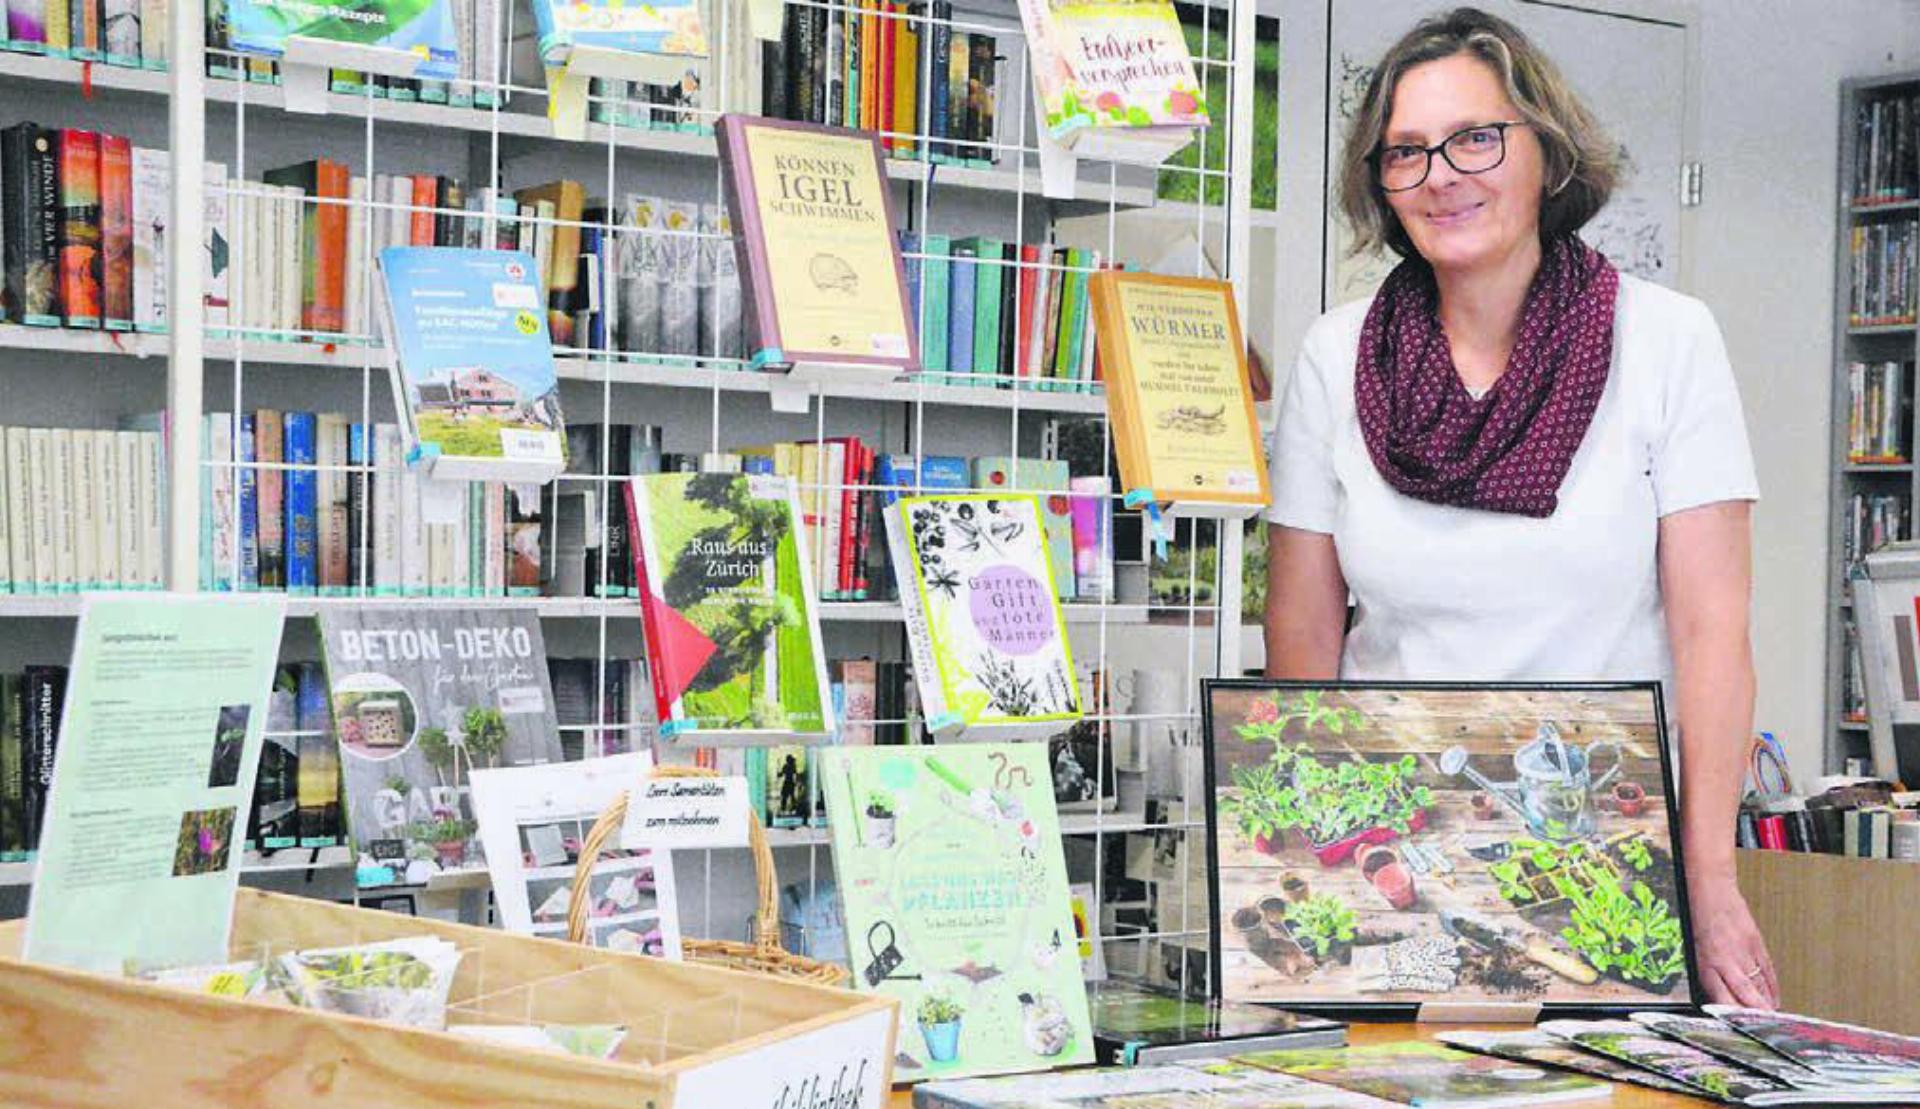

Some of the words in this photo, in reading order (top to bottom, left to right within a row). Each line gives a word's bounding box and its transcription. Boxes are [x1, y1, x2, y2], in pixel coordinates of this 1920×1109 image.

[774, 153, 857, 177] KÖNNEN
[43, 154, 54, 206] WINDE
[779, 173, 863, 207] IGEL
[770, 200, 876, 223] SCHWIMMEN
[1131, 316, 1227, 341] WÜRMER
[691, 538, 735, 556] Raus
[738, 541, 767, 555] aus
[705, 559, 759, 578] Zürich
[340, 626, 532, 661] BETON-DEKO
[645, 818, 666, 828] zum
[668, 809, 720, 825] mitnehmen
